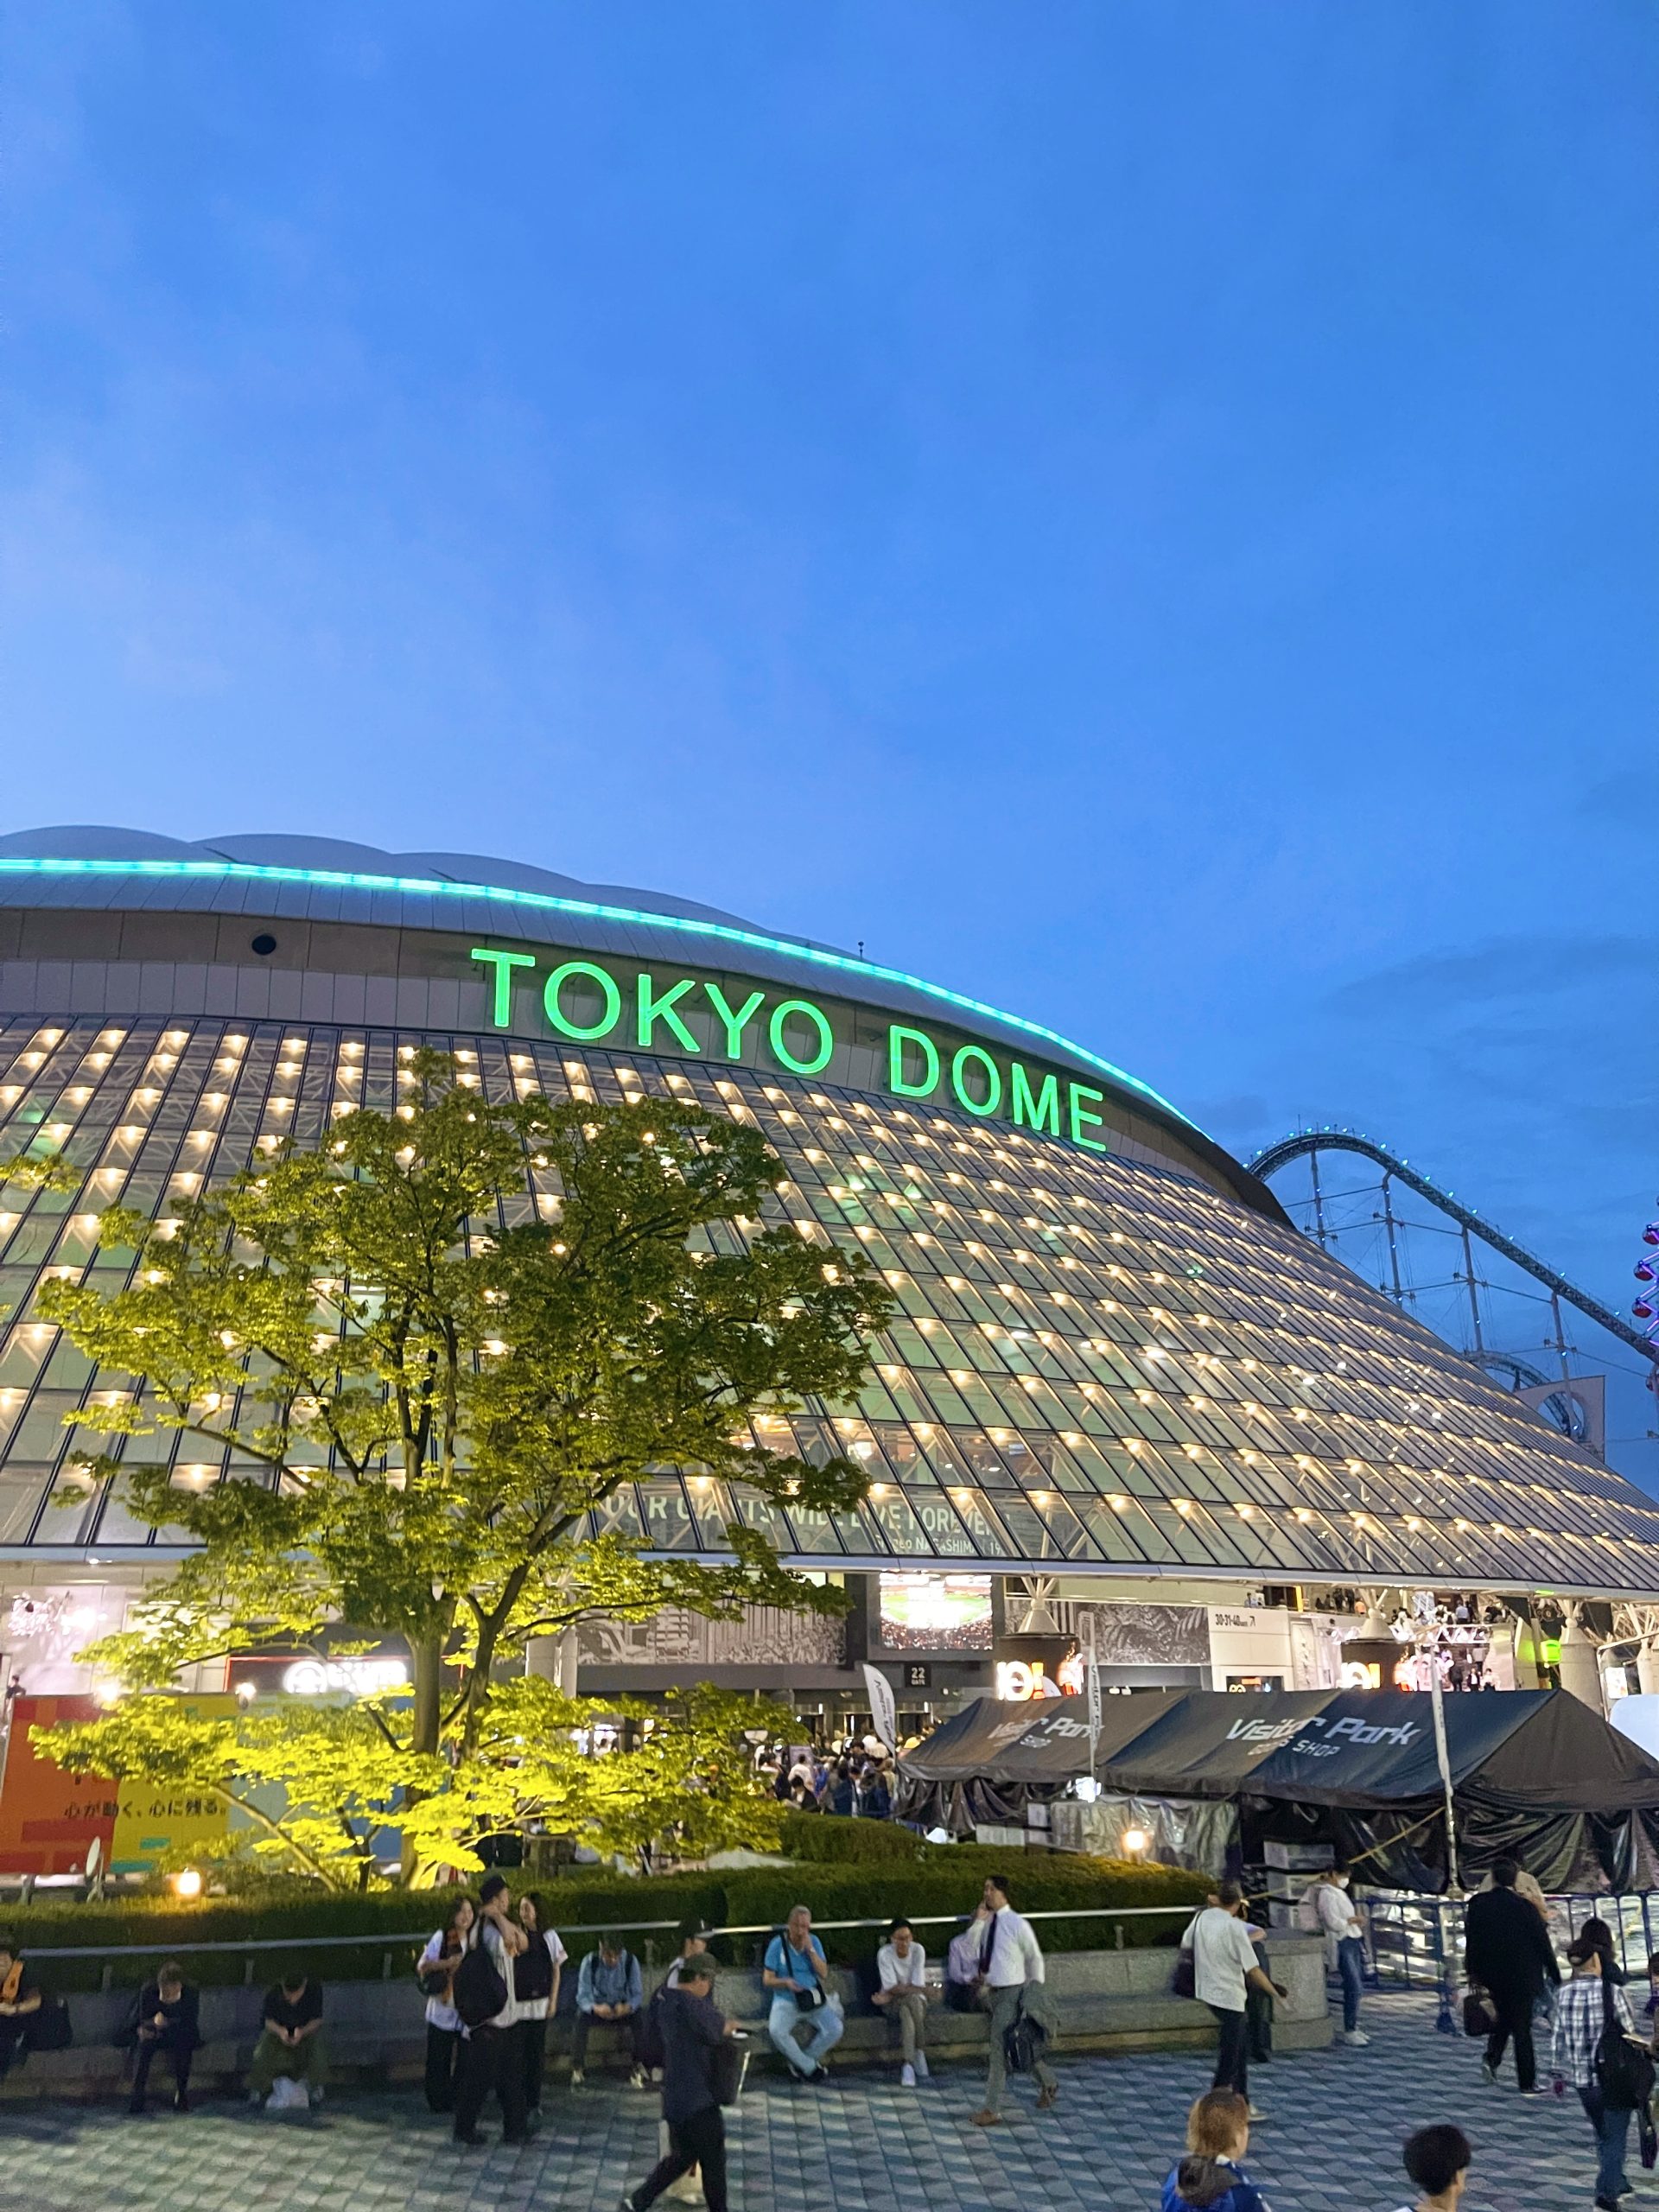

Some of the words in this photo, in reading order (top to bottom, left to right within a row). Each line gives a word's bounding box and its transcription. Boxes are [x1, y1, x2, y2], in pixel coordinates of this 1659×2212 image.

[471, 948, 833, 1074] TOKYO
[889, 1024, 1107, 1152] DOME
[912, 1667, 925, 1679] 22
[1226, 1715, 1328, 1741] Visitor
[1325, 1716, 1421, 1745] Park
[1293, 1739, 1341, 1758] SHOP
